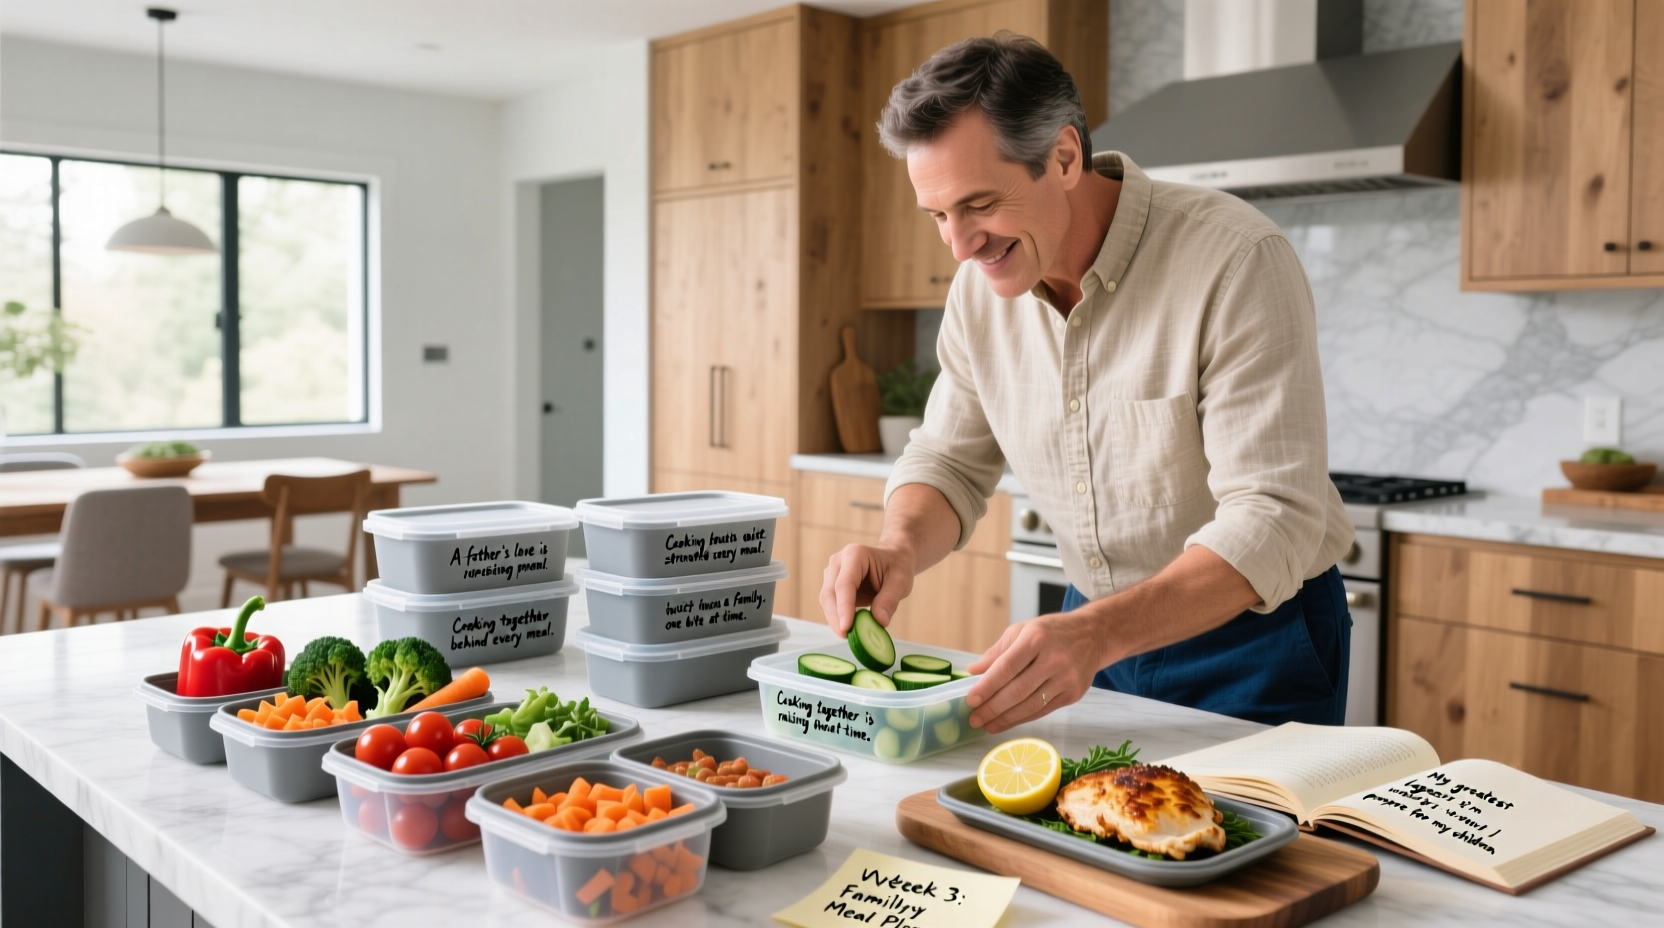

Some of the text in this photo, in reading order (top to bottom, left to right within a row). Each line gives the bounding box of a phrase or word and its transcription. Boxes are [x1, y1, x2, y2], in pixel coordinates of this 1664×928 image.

[450, 541, 548, 566] A father's love is
[451, 631, 489, 650] behind
[492, 632, 522, 648] every
[1427, 771, 1452, 786] My
[943, 887, 966, 906] 3:
[823, 900, 877, 923] Meal
